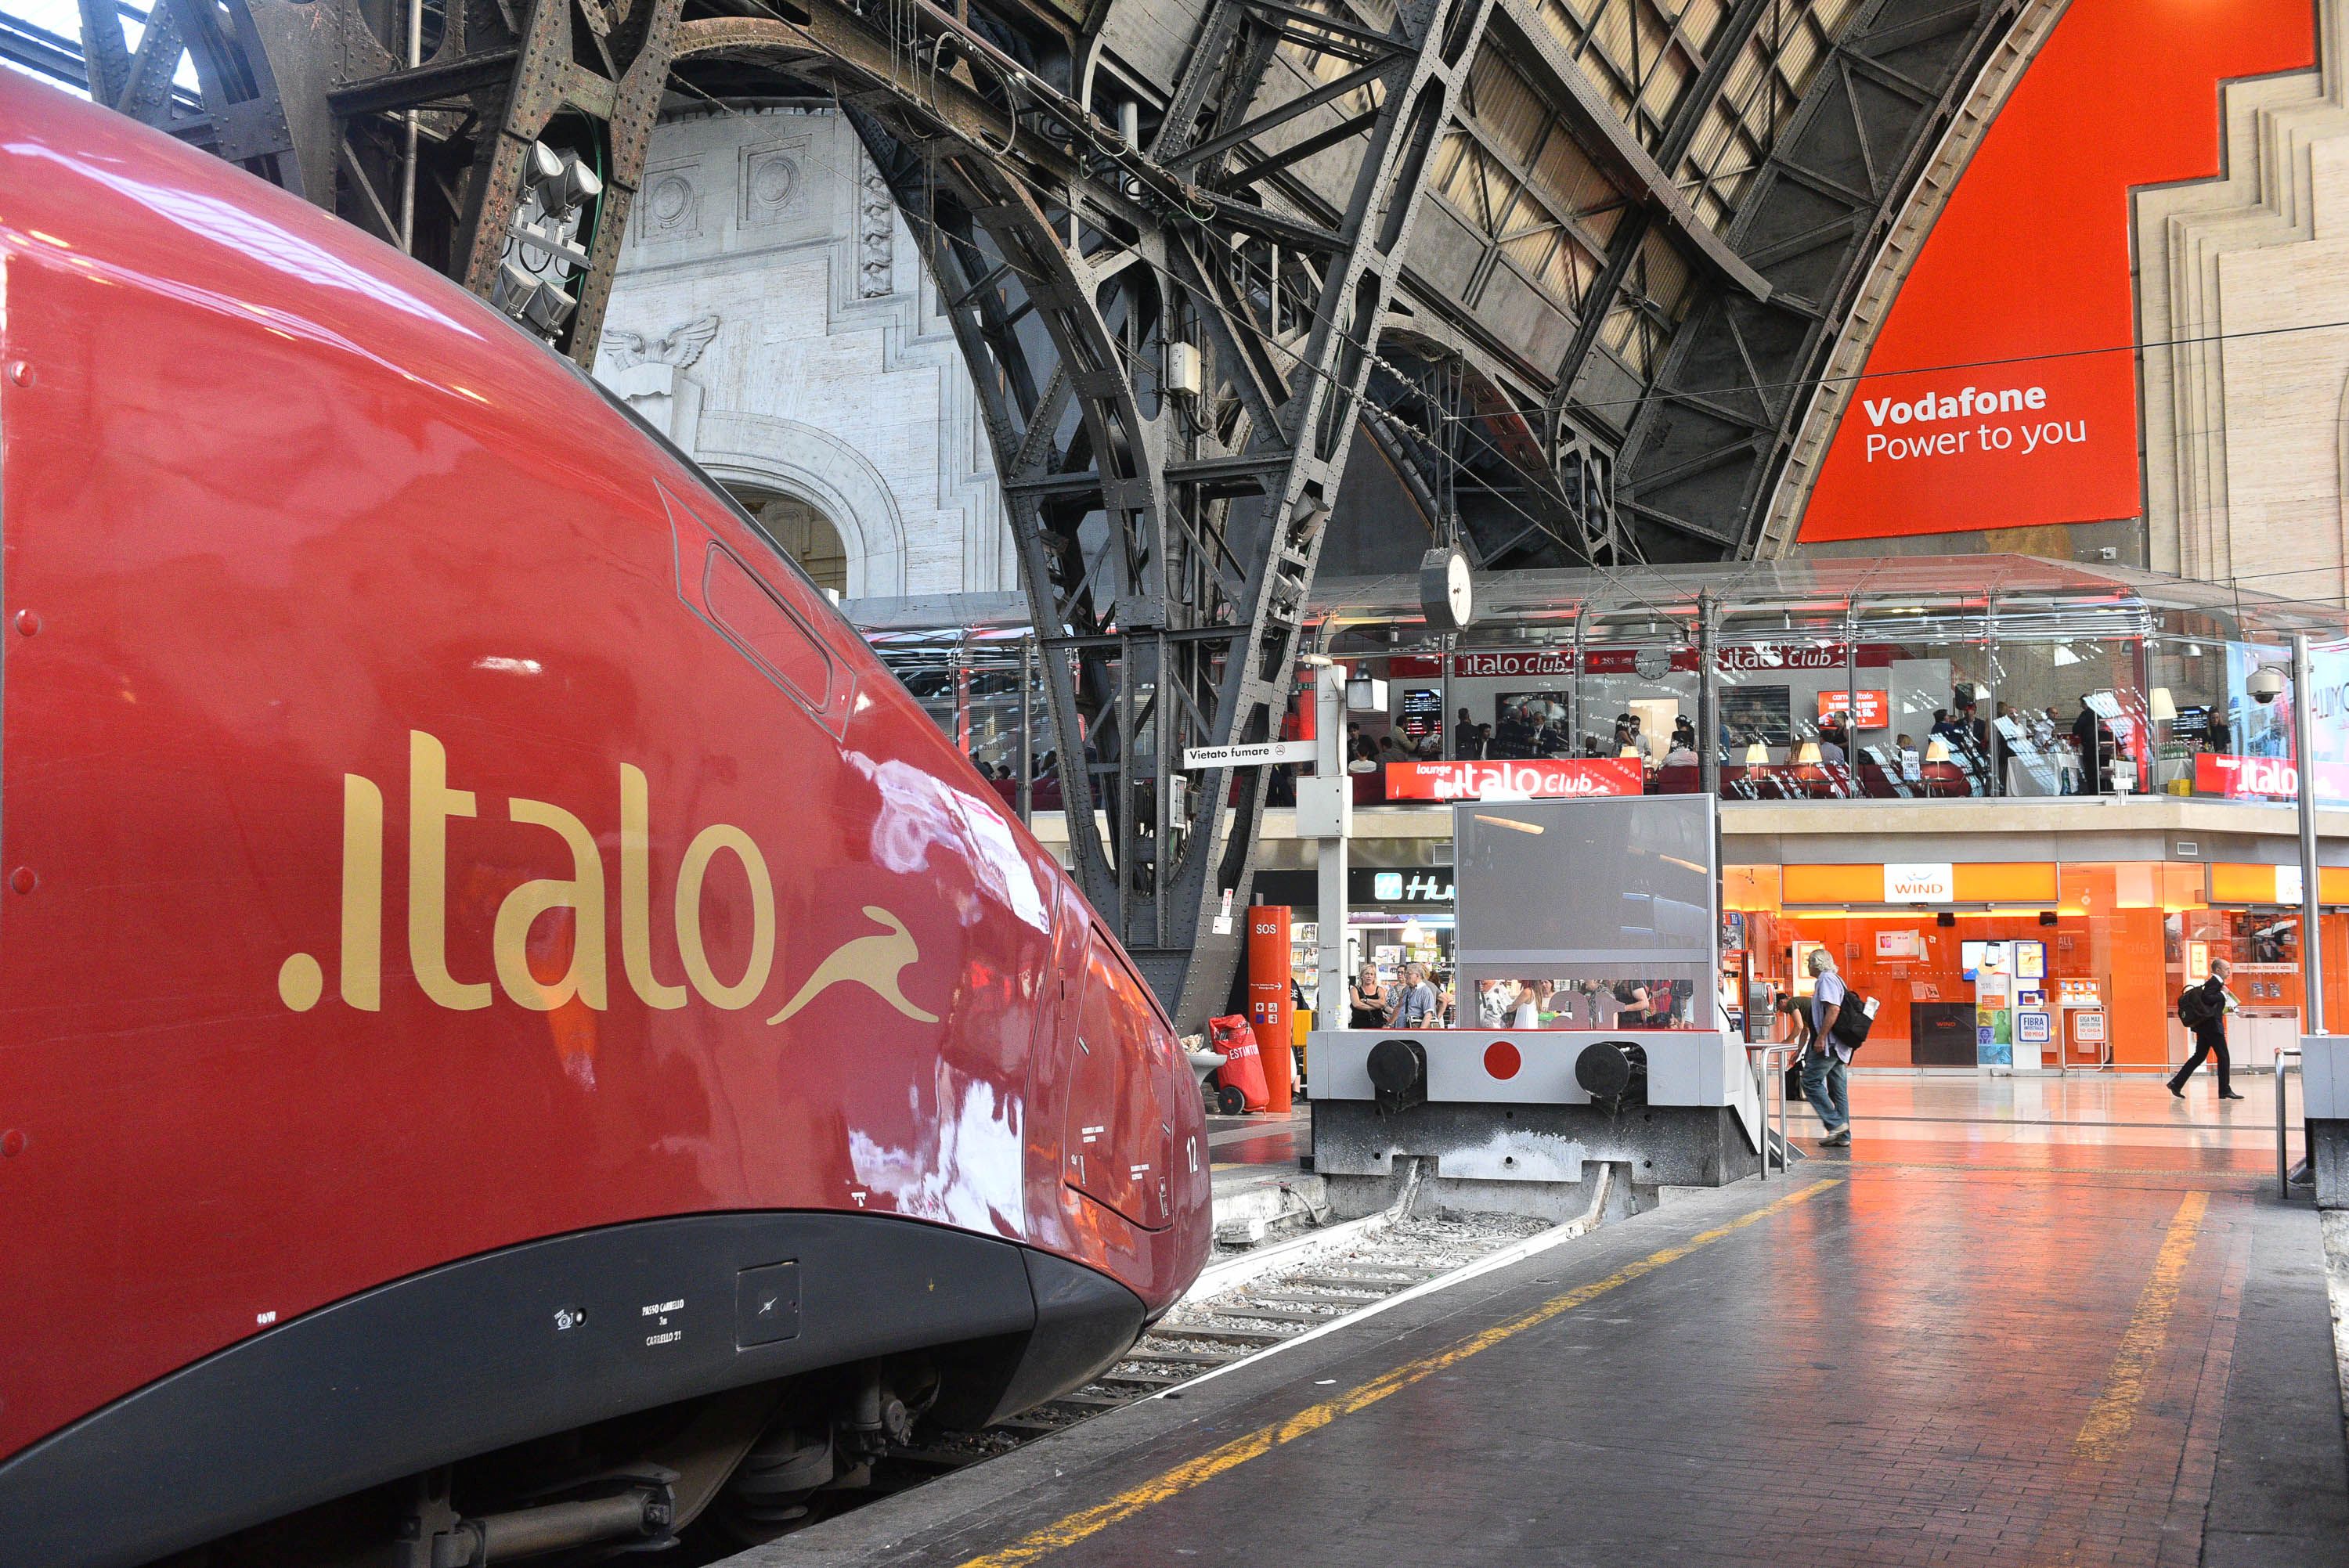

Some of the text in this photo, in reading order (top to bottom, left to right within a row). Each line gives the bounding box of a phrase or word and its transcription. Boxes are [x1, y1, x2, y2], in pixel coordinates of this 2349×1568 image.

[1863, 386, 2048, 427] Vodafone
[1867, 420, 2087, 463] Power to you
[1523, 657, 1567, 673] club
[1788, 649, 1831, 667] club
[1189, 747, 1270, 760] Vietato fumare
[1416, 763, 1452, 777] lounge
[1543, 773, 1592, 794] club
[1406, 875, 1456, 900] Hu
[1894, 883, 1943, 895] WIND
[1256, 924, 1277, 935] SOS
[2023, 1017, 2044, 1026] FIBRA
[1229, 1044, 1259, 1060] ESTINTO
[1186, 1135, 1199, 1174] 12
[642, 1299, 684, 1317] PASSO CARRELLO
[646, 1331, 682, 1346] CARRELLO 21
